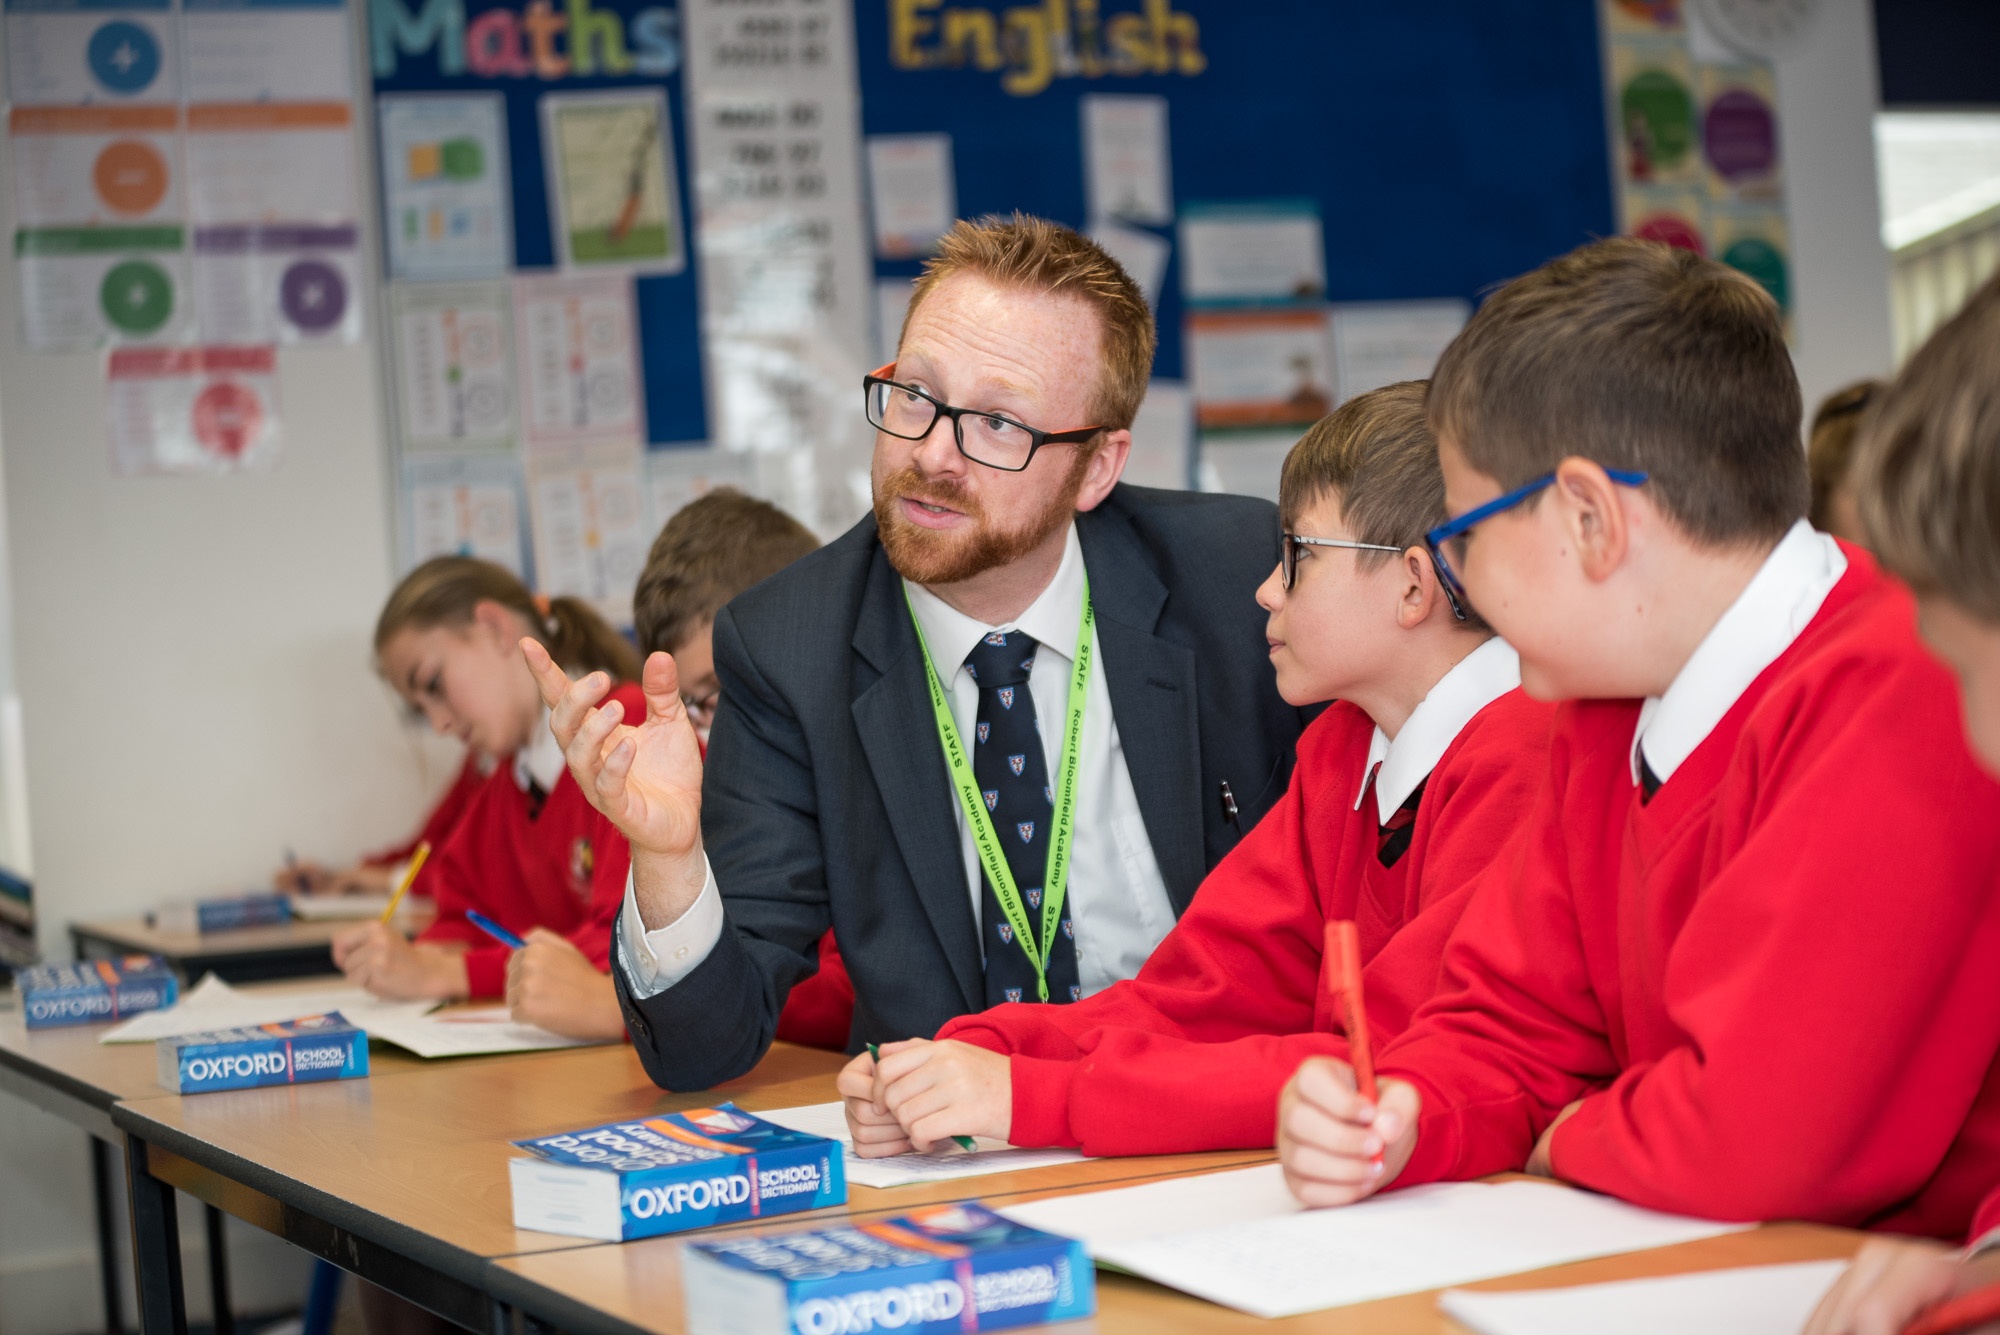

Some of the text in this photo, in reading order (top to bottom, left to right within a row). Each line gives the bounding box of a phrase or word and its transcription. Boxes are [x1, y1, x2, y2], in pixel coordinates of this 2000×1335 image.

[372, 0, 682, 79] Maths
[889, 0, 1207, 95] English
[1077, 644, 1089, 692] STAFF
[942, 723, 963, 768] STAFF
[1069, 708, 1081, 753] Robert
[1060, 754, 1077, 826] Bloomfield
[963, 784, 988, 842] Academy
[982, 844, 1015, 910] Bloomfield
[1051, 828, 1067, 888] Academy
[1012, 911, 1034, 953] Robert
[32, 995, 112, 1020] OXFORD
[188, 1051, 286, 1081] OXFORD
[294, 1047, 346, 1062] SCHOOL
[295, 1059, 346, 1072] DICTIONARY
[629, 1174, 751, 1219] OXFORD
[758, 1164, 821, 1188] SCHOOL
[759, 1179, 821, 1199] DICTIONARY
[795, 1278, 965, 1335] OXFORD
